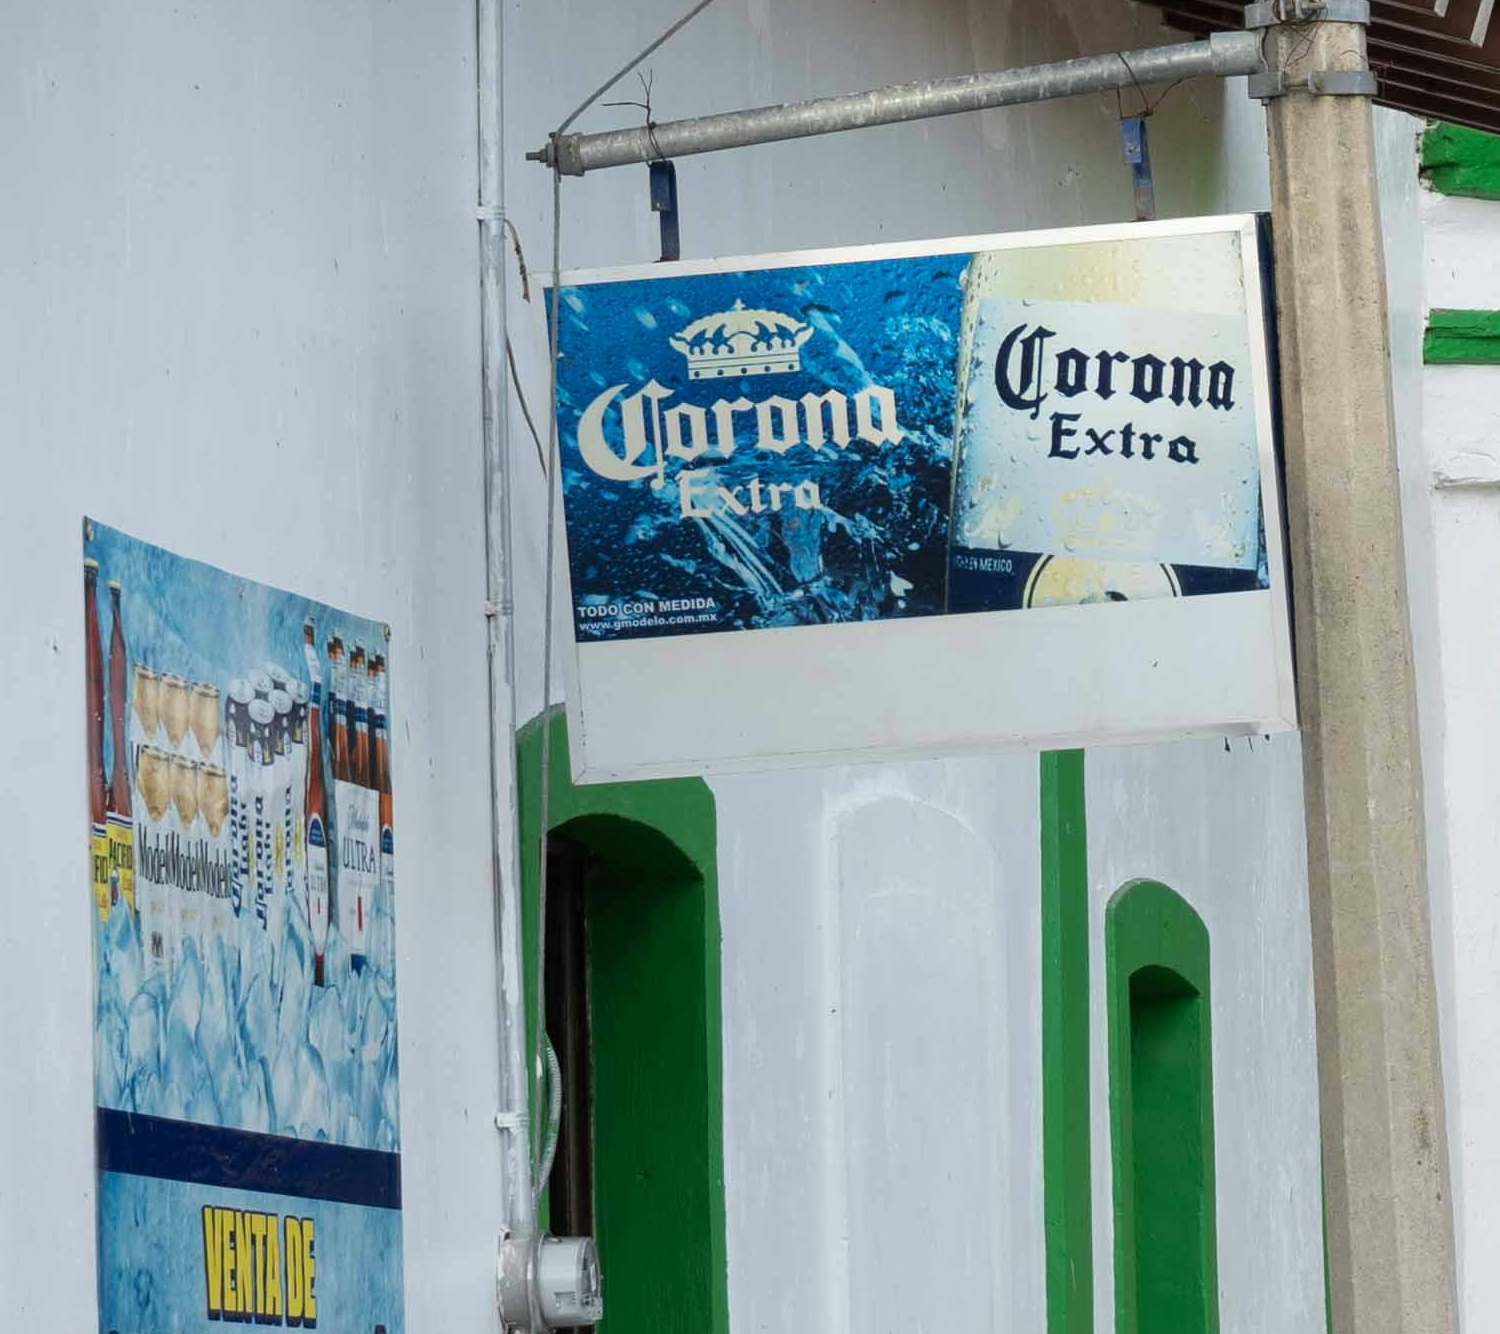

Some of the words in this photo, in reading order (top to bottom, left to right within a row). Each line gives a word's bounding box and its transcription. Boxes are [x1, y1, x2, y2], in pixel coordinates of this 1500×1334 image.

[995, 323, 1236, 420] Corona
[577, 377, 904, 492] Corona
[1048, 411, 1201, 465] Extra
[674, 469, 823, 521] Extra
[578, 604, 619, 618] TODO
[623, 601, 655, 615] CON
[659, 597, 717, 613] MEDIDA
[579, 613, 718, 631] www.gmodelo.com.mx
[342, 836, 378, 874] ULTRA
[202, 1204, 283, 1324] VENTA
[284, 1214, 318, 1329] DE
